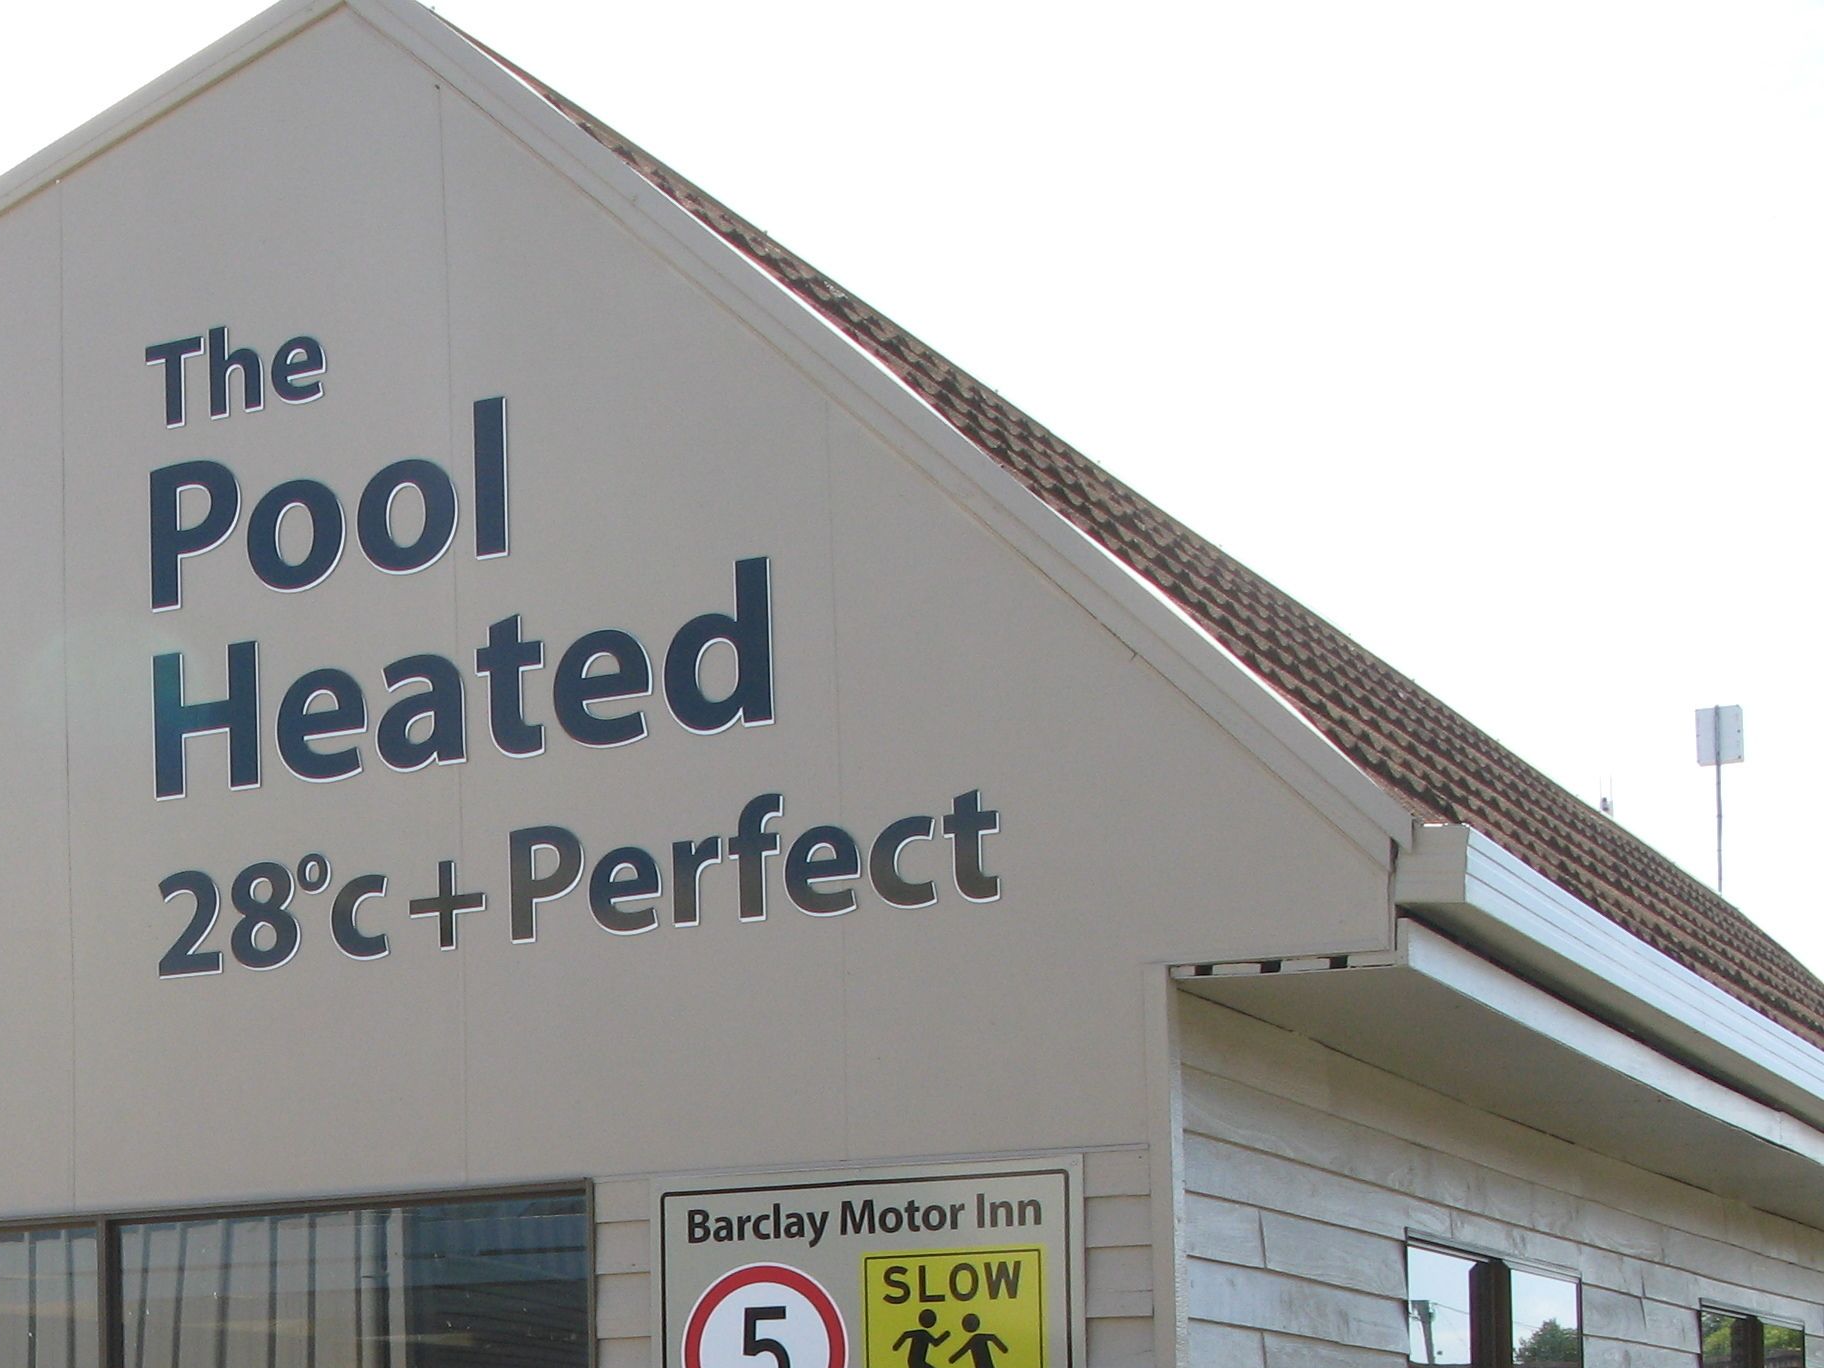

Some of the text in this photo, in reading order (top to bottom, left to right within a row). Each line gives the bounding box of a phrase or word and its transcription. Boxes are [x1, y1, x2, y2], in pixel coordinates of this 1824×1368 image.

[145, 326, 326, 428] The
[149, 396, 509, 613] Pool
[151, 556, 775, 801] Heated
[509, 789, 1001, 944] Perfect
[687, 1193, 1043, 1248] Barclay Motor Inn
[882, 1260, 1022, 1305] SLOW
